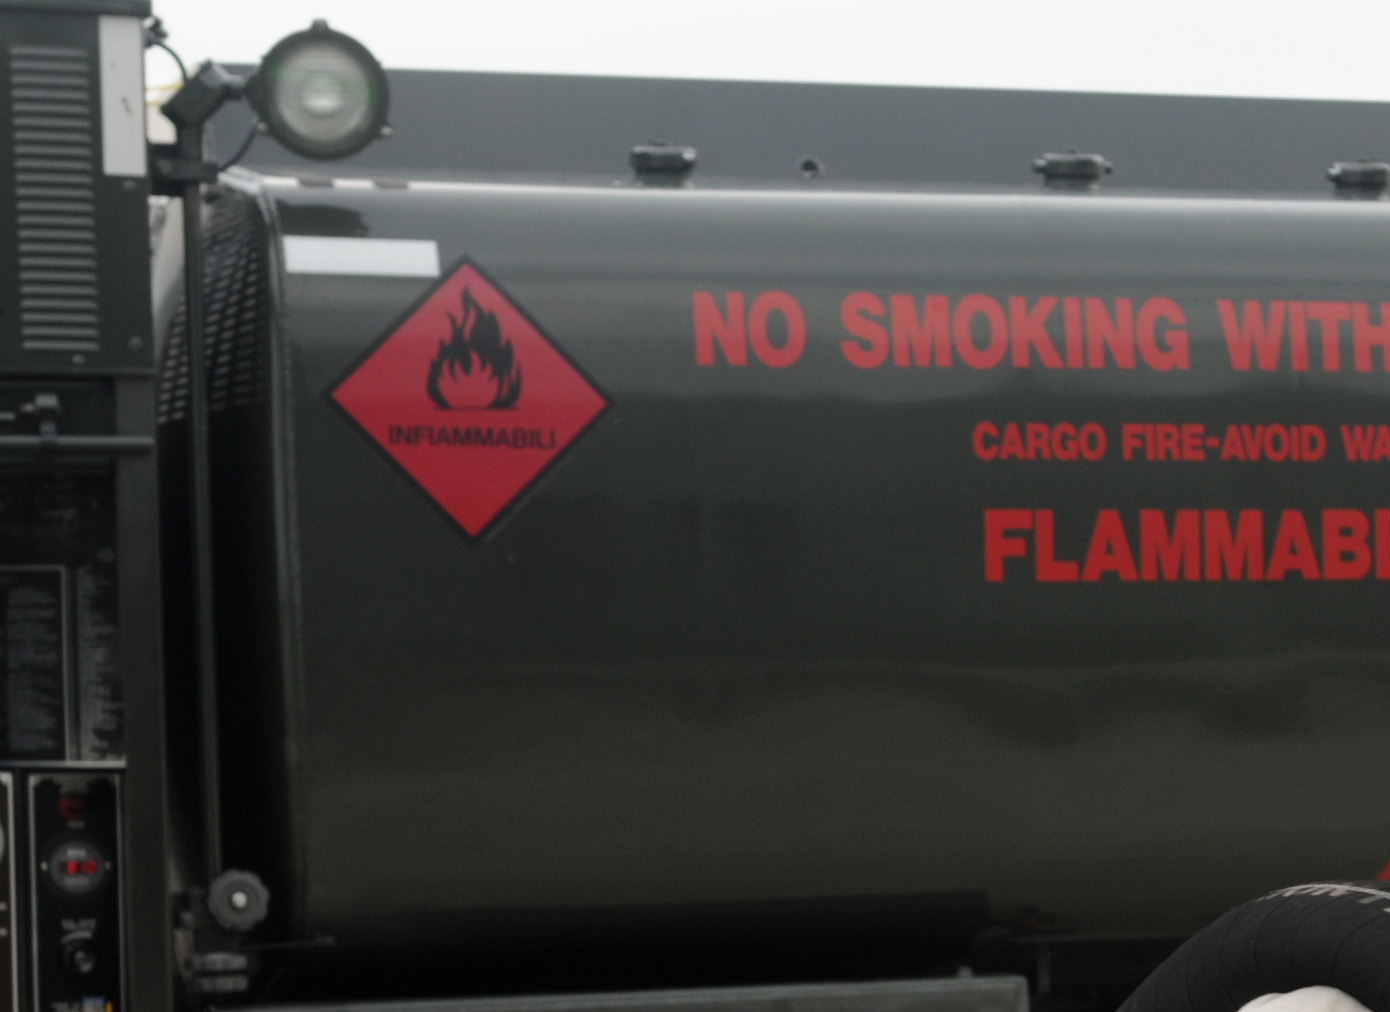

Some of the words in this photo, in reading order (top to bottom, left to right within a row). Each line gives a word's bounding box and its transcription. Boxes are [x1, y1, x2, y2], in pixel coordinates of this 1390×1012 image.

[693, 290, 807, 368] NO
[840, 291, 1190, 372] SMOKING
[387, 423, 558, 450] INFIAMMABILI
[972, 420, 1108, 462] CARGO
[1121, 422, 1327, 463] FIRE-AVOID
